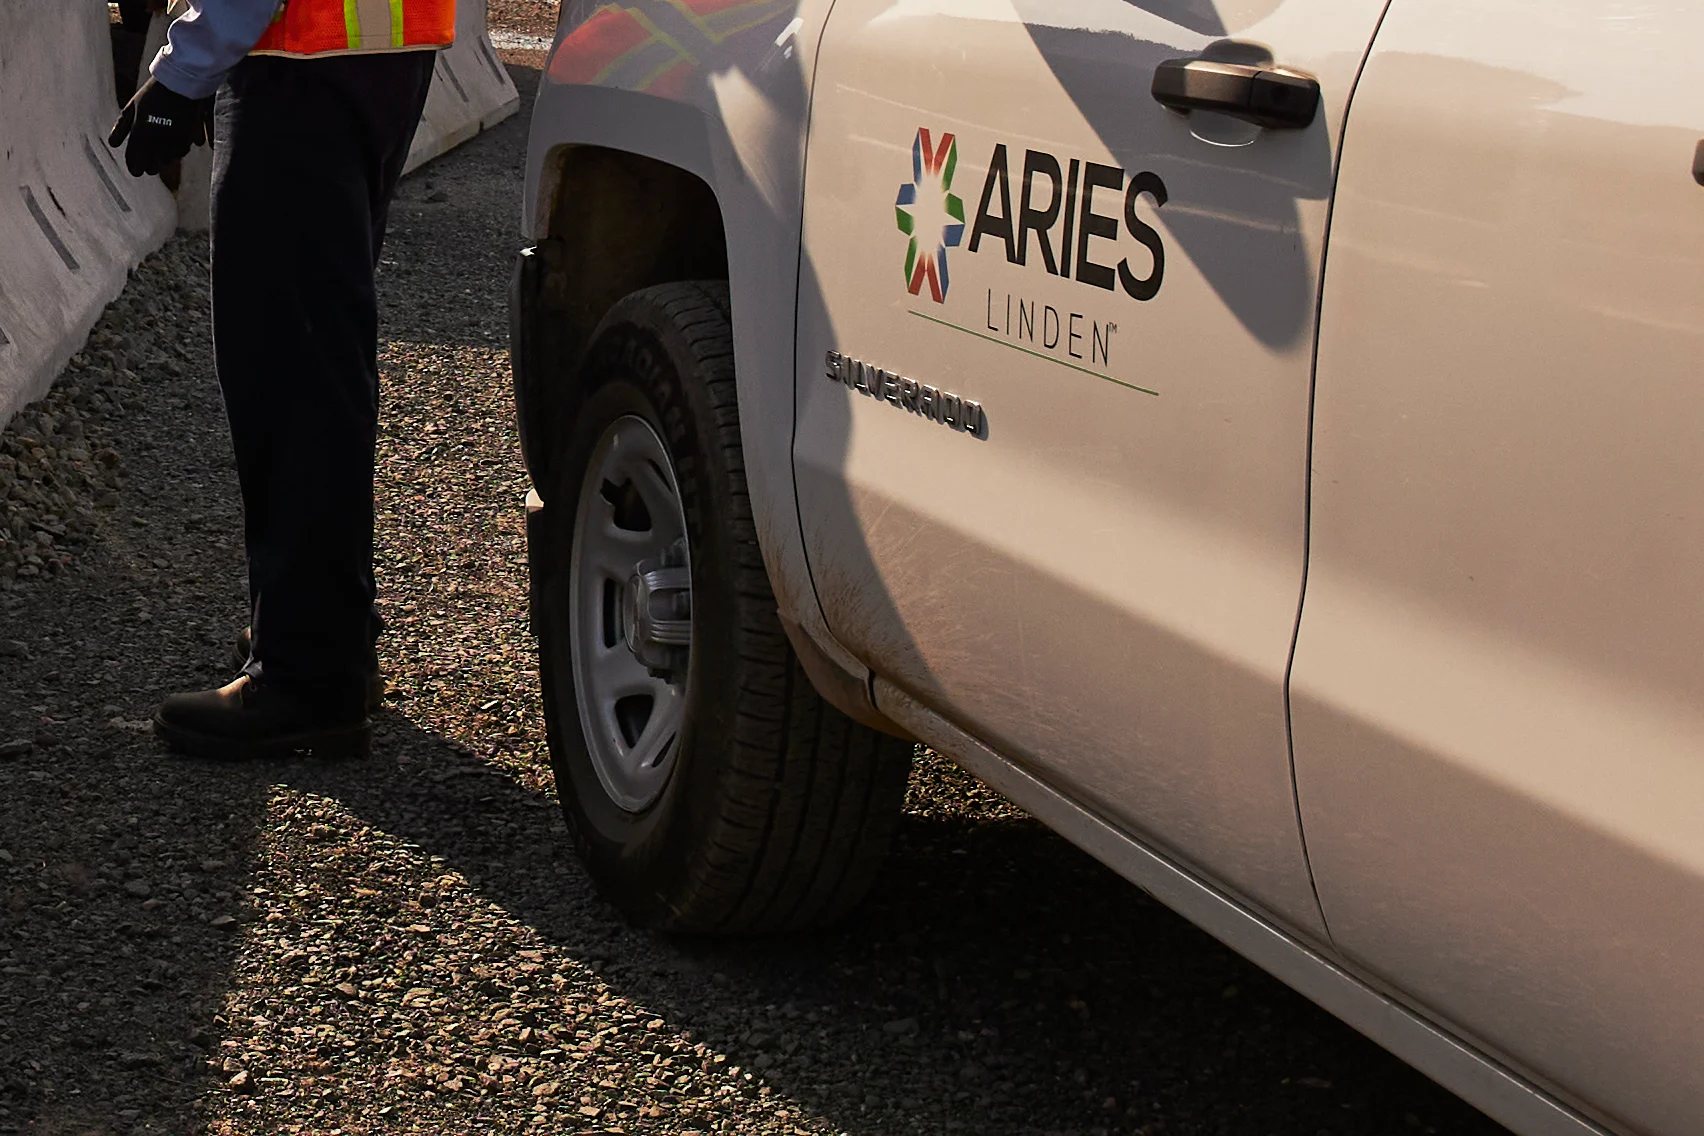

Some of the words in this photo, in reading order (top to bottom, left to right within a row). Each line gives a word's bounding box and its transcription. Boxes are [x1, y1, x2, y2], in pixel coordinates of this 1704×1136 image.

[147, 114, 172, 127] ULINE
[967, 142, 1169, 302] ARIES
[825, 350, 982, 436] SILVERADO
